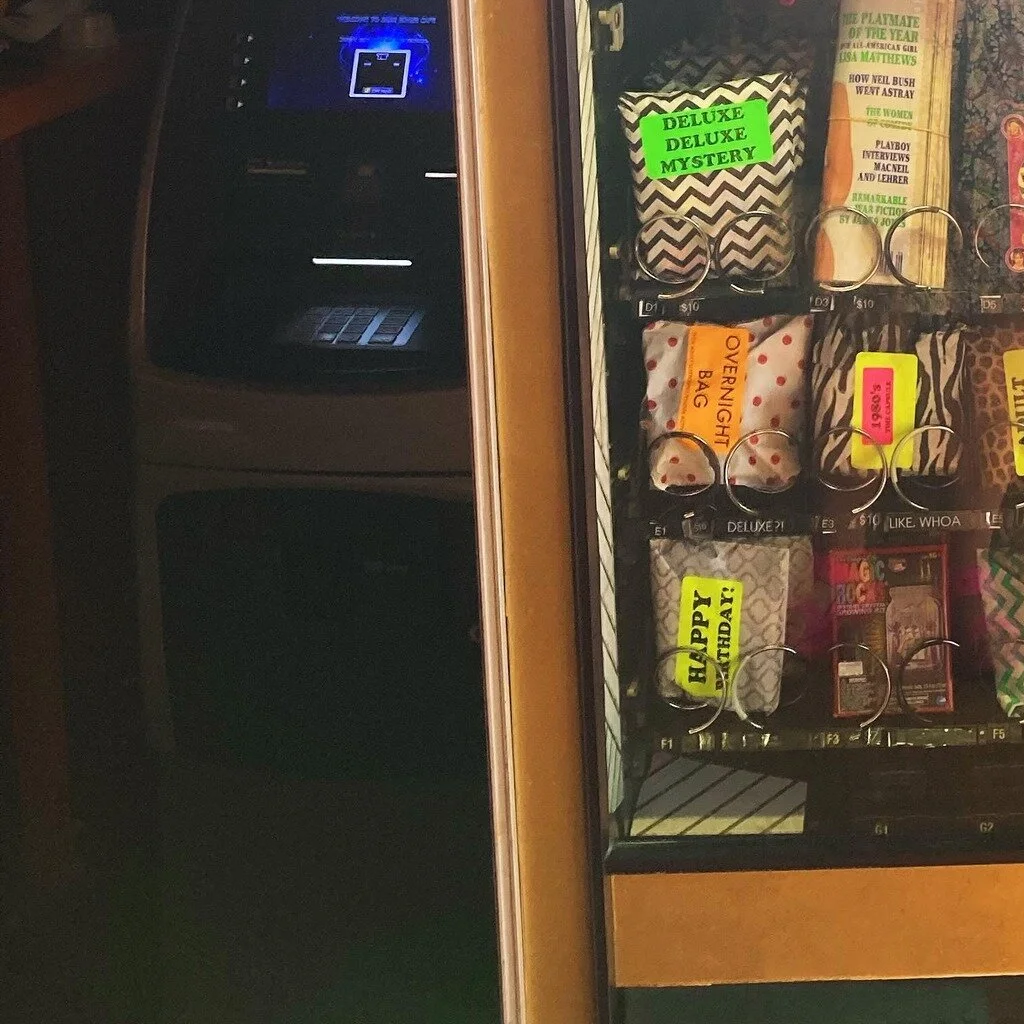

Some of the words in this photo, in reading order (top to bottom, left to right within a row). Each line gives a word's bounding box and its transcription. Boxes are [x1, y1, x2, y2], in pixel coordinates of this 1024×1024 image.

[861, 12, 920, 28] PLAYMATE
[848, 27, 861, 39] OF
[865, 27, 887, 40] THE
[890, 28, 919, 43] YEAR
[902, 44, 918, 53] GIRL
[838, 51, 858, 63] LISA
[860, 51, 918, 66] MATTHEWS
[848, 73, 870, 84] HOW
[871, 74, 891, 85] NEIL
[892, 75, 916, 88] BUSH
[855, 85, 880, 96] WENT
[881, 87, 916, 100] ASTRAY
[662, 106, 745, 131] DELUXE
[865, 107, 882, 117] THE
[882, 107, 913, 120] WOMEN
[665, 127, 748, 152] DELUXE
[875, 139, 912, 152] PLAYBOY
[660, 146, 757, 174] MYSTERY
[862, 150, 911, 163] INTERVIEWS
[873, 162, 910, 174] MACNEIL
[857, 172, 876, 182] AND
[876, 173, 909, 185] LEHRER
[851, 192, 908, 206] REMARKABLE
[838, 214, 850, 225] BY
[645, 302, 658, 312] D1
[680, 301, 700, 313] $10
[814, 296, 829, 308] D3
[855, 299, 874, 310] $10
[982, 299, 998, 310] D5
[692, 370, 714, 410] BAG
[713, 334, 742, 449] OVERNIGHT
[885, 380, 893, 416] CAPSULE
[870, 383, 882, 430] 1980's
[655, 526, 666, 536] E1
[727, 520, 785, 534] DELUXE?!
[821, 519, 835, 529] E3
[858, 513, 881, 527] $10
[919, 515, 962, 529] WHOA
[687, 589, 712, 685] HAPPY
[826, 732, 840, 745] F3
[992, 728, 1006, 740] F5
[660, 739, 674, 750] F1
[979, 822, 995, 834] G2
